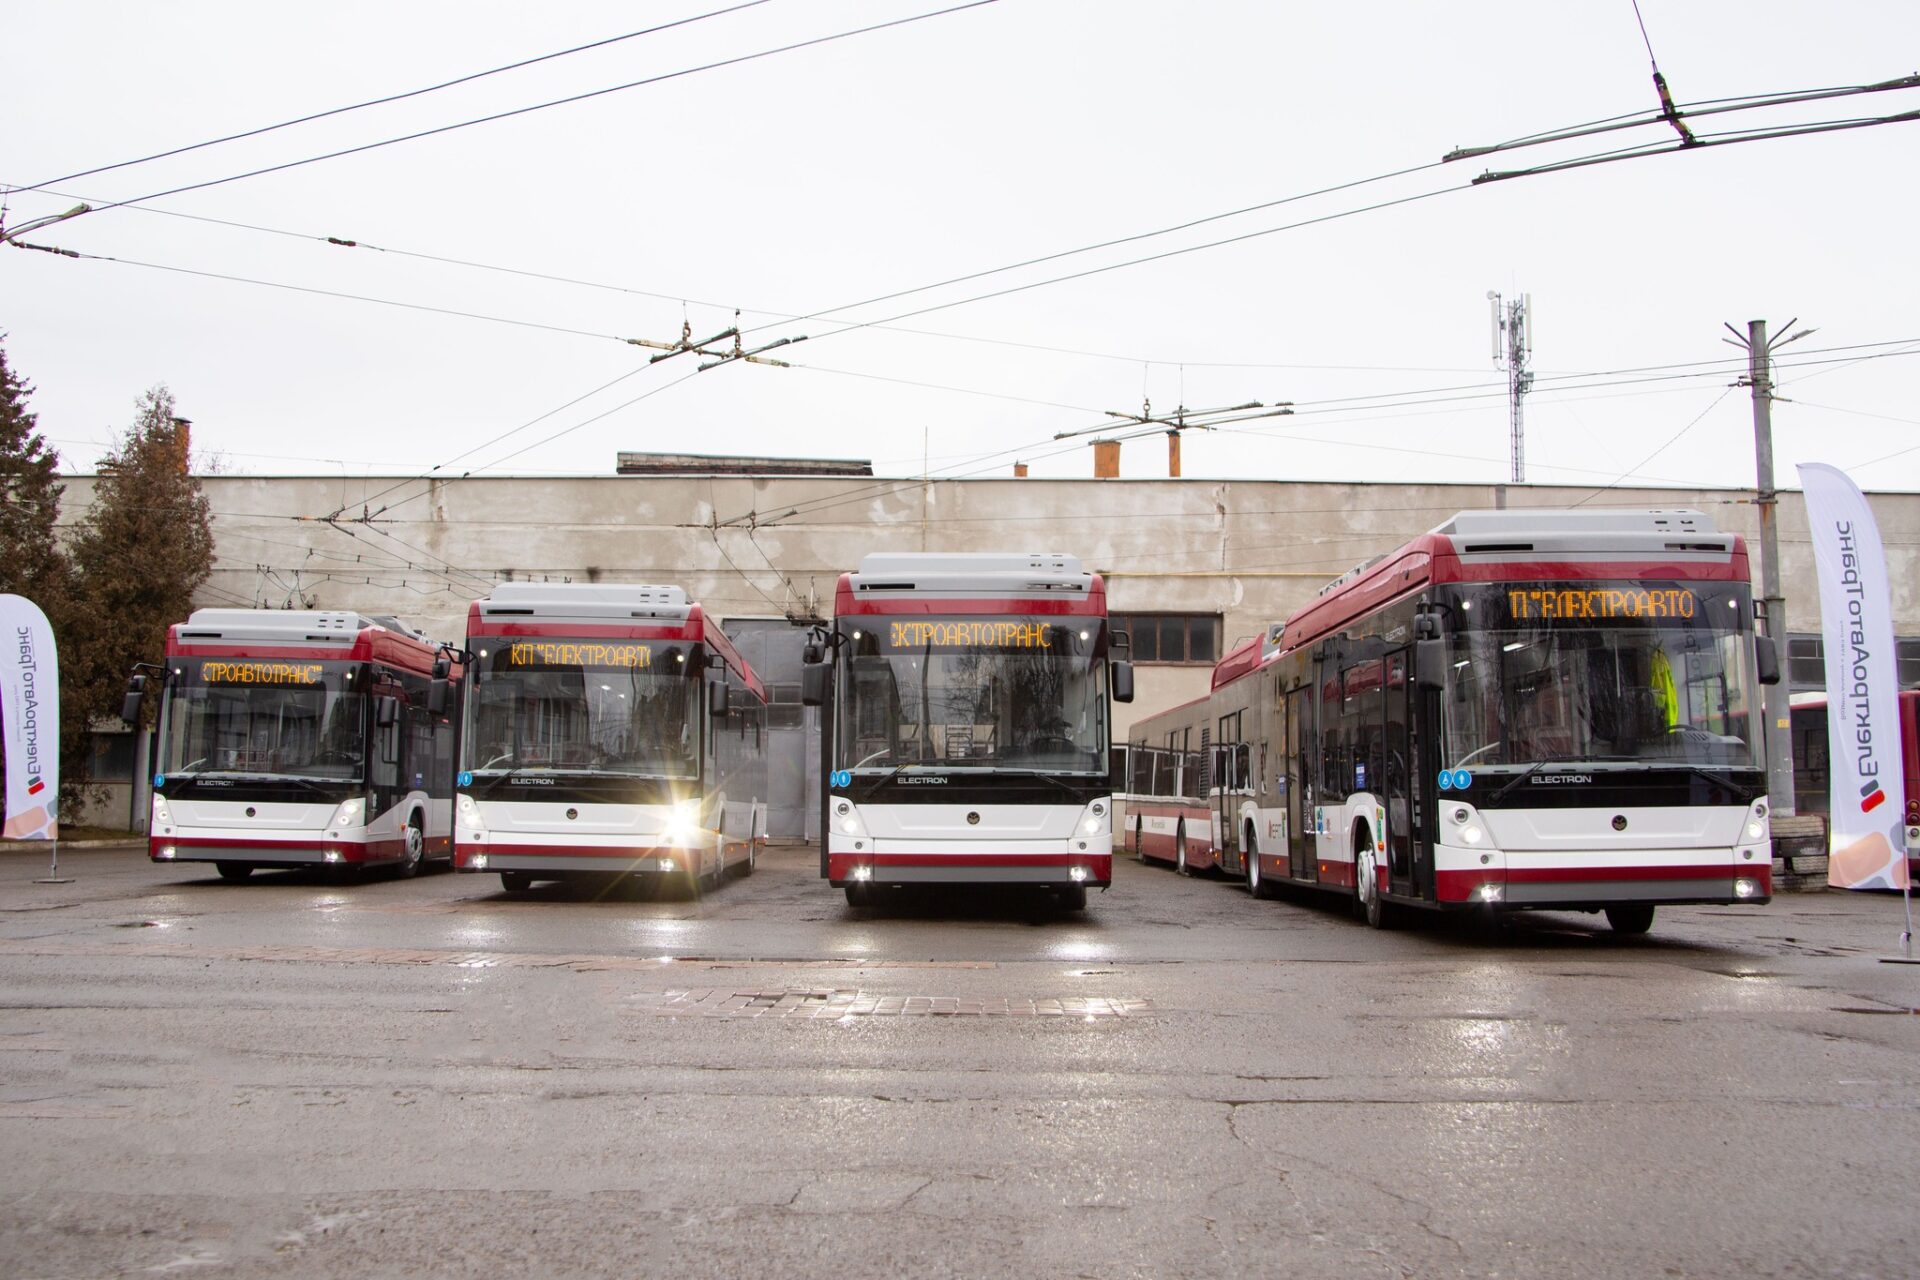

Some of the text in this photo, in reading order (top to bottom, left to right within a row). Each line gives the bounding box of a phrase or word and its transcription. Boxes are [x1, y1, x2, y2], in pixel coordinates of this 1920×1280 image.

[511, 643, 533, 665] КП
[897, 777, 948, 785] ELECTRON
[1531, 775, 1592, 784] ELECTRON
